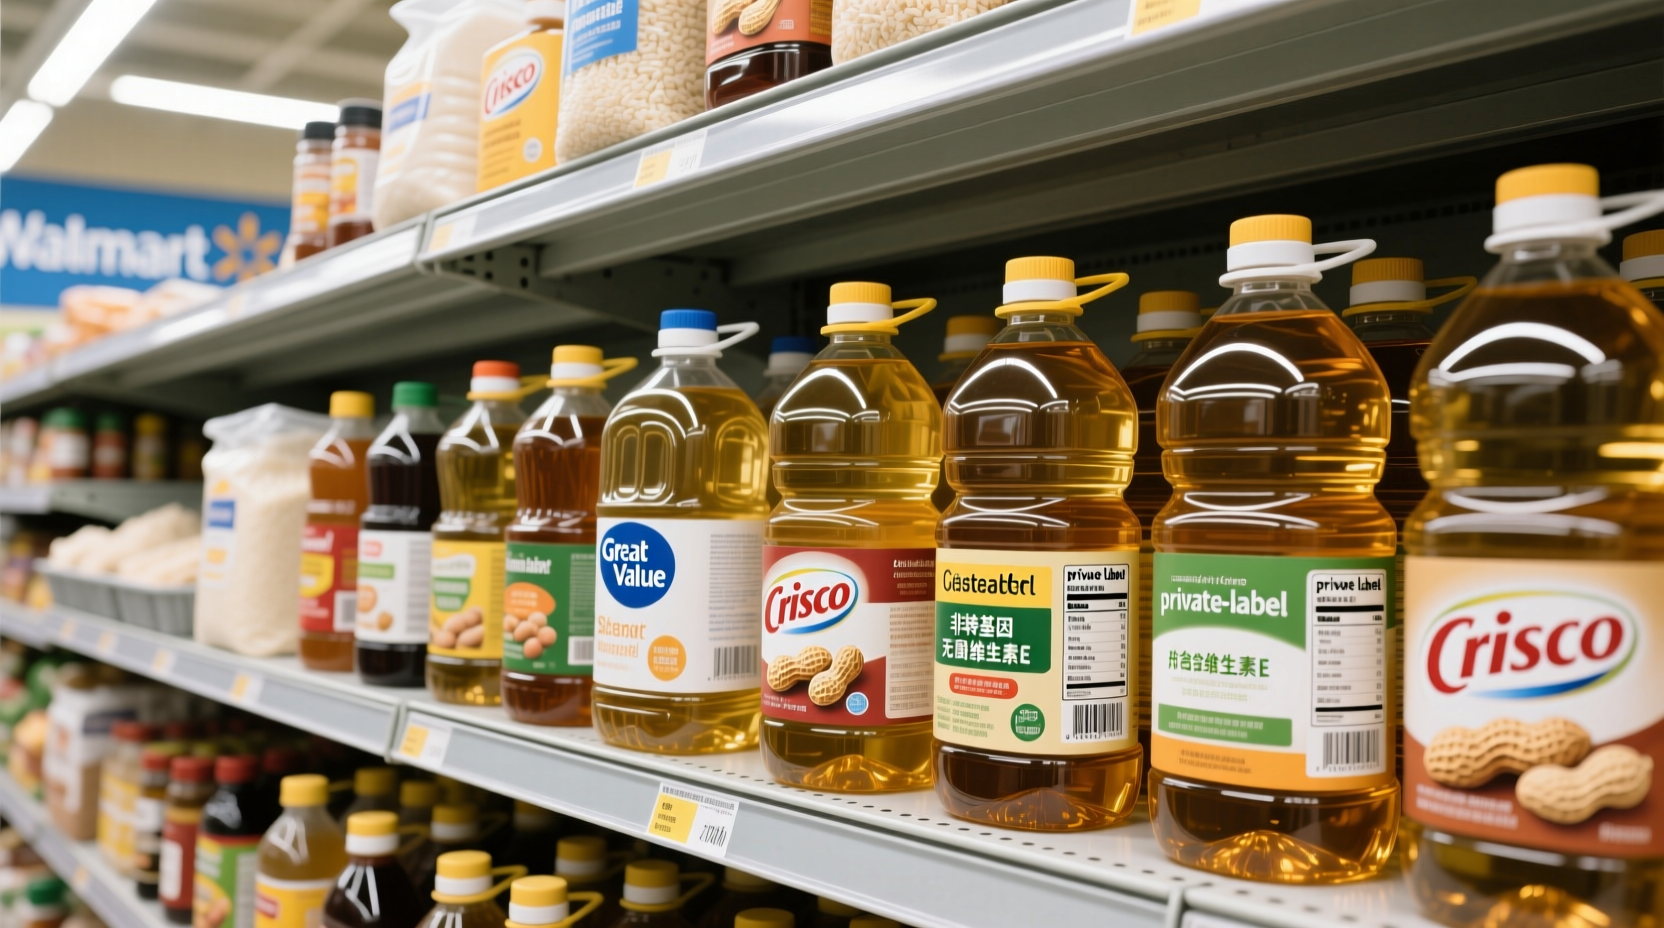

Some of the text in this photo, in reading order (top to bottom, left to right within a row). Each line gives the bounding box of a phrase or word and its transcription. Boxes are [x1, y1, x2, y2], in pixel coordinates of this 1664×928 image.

[485, 62, 536, 115] Crisco
[0, 208, 211, 281] Walmart
[602, 537, 649, 563] Great
[612, 563, 667, 588] Value
[764, 581, 851, 634] Crisco
[1161, 586, 1289, 618] private-label
[1426, 611, 1624, 695] Crisco
